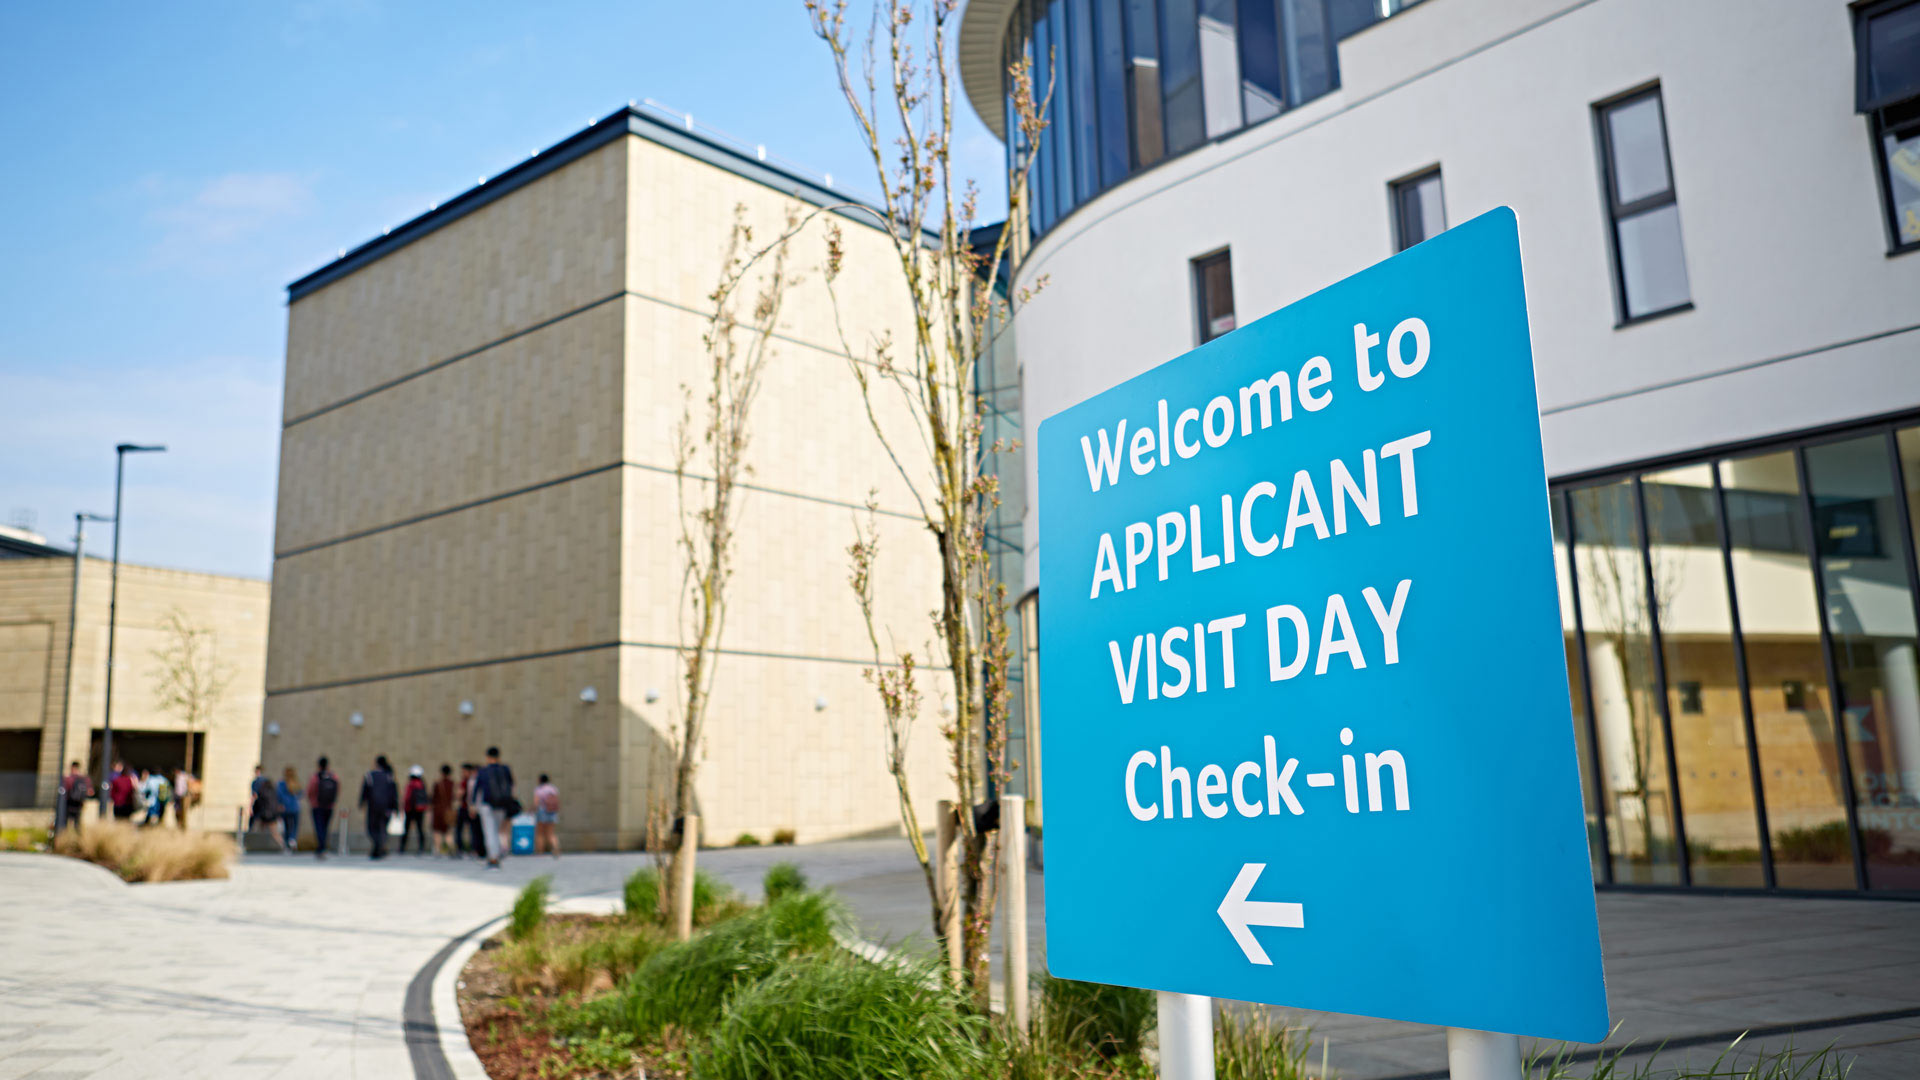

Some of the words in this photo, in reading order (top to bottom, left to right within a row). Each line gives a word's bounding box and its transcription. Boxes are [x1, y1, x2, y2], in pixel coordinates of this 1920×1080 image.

[1080, 355, 1333, 493] Welcome
[1353, 317, 1431, 392] to
[1090, 430, 1432, 600] APPLICANT
[1108, 613, 1247, 705] VISIT
[1266, 579, 1412, 682] DAY
[1125, 727, 1410, 822] Check-in
